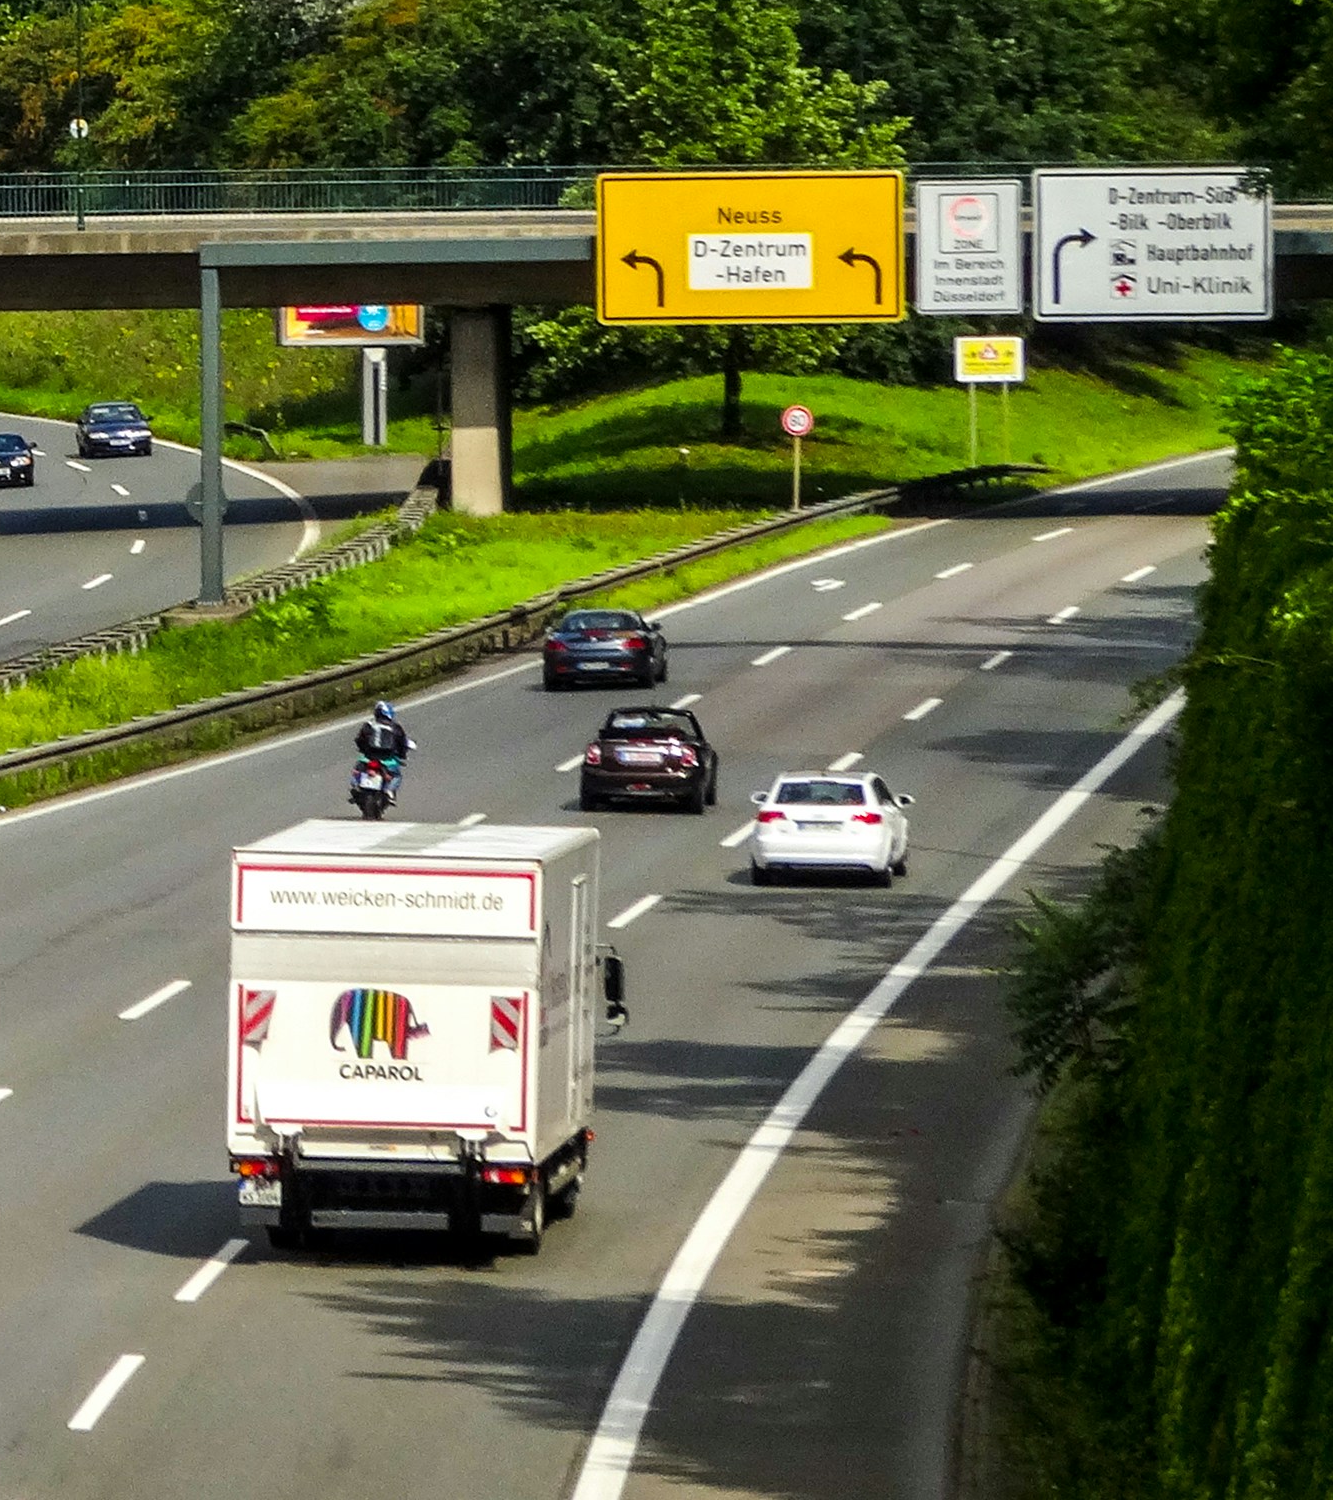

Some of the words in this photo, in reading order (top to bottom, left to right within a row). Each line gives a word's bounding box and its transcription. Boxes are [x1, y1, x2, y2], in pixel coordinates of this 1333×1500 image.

[717, 207, 783, 224] Neuss
[1109, 212, 1149, 230] -Bilk
[1158, 212, 1233, 230] -Oberbilk
[694, 240, 806, 258] D-Zentrum
[954, 239, 984, 250] ZONE
[955, 258, 1005, 270] Bereich
[1146, 244, 1255, 266] Hauptbahnhof
[715, 265, 786, 283] -Hafen
[935, 275, 1004, 287] Innenstadt
[1147, 276, 1253, 295] Uni-Klinik
[933, 290, 1006, 302] Düsseldorf
[270, 888, 504, 911] www.weicken-schmidt.de
[339, 1063, 425, 1082] CAPAROL
